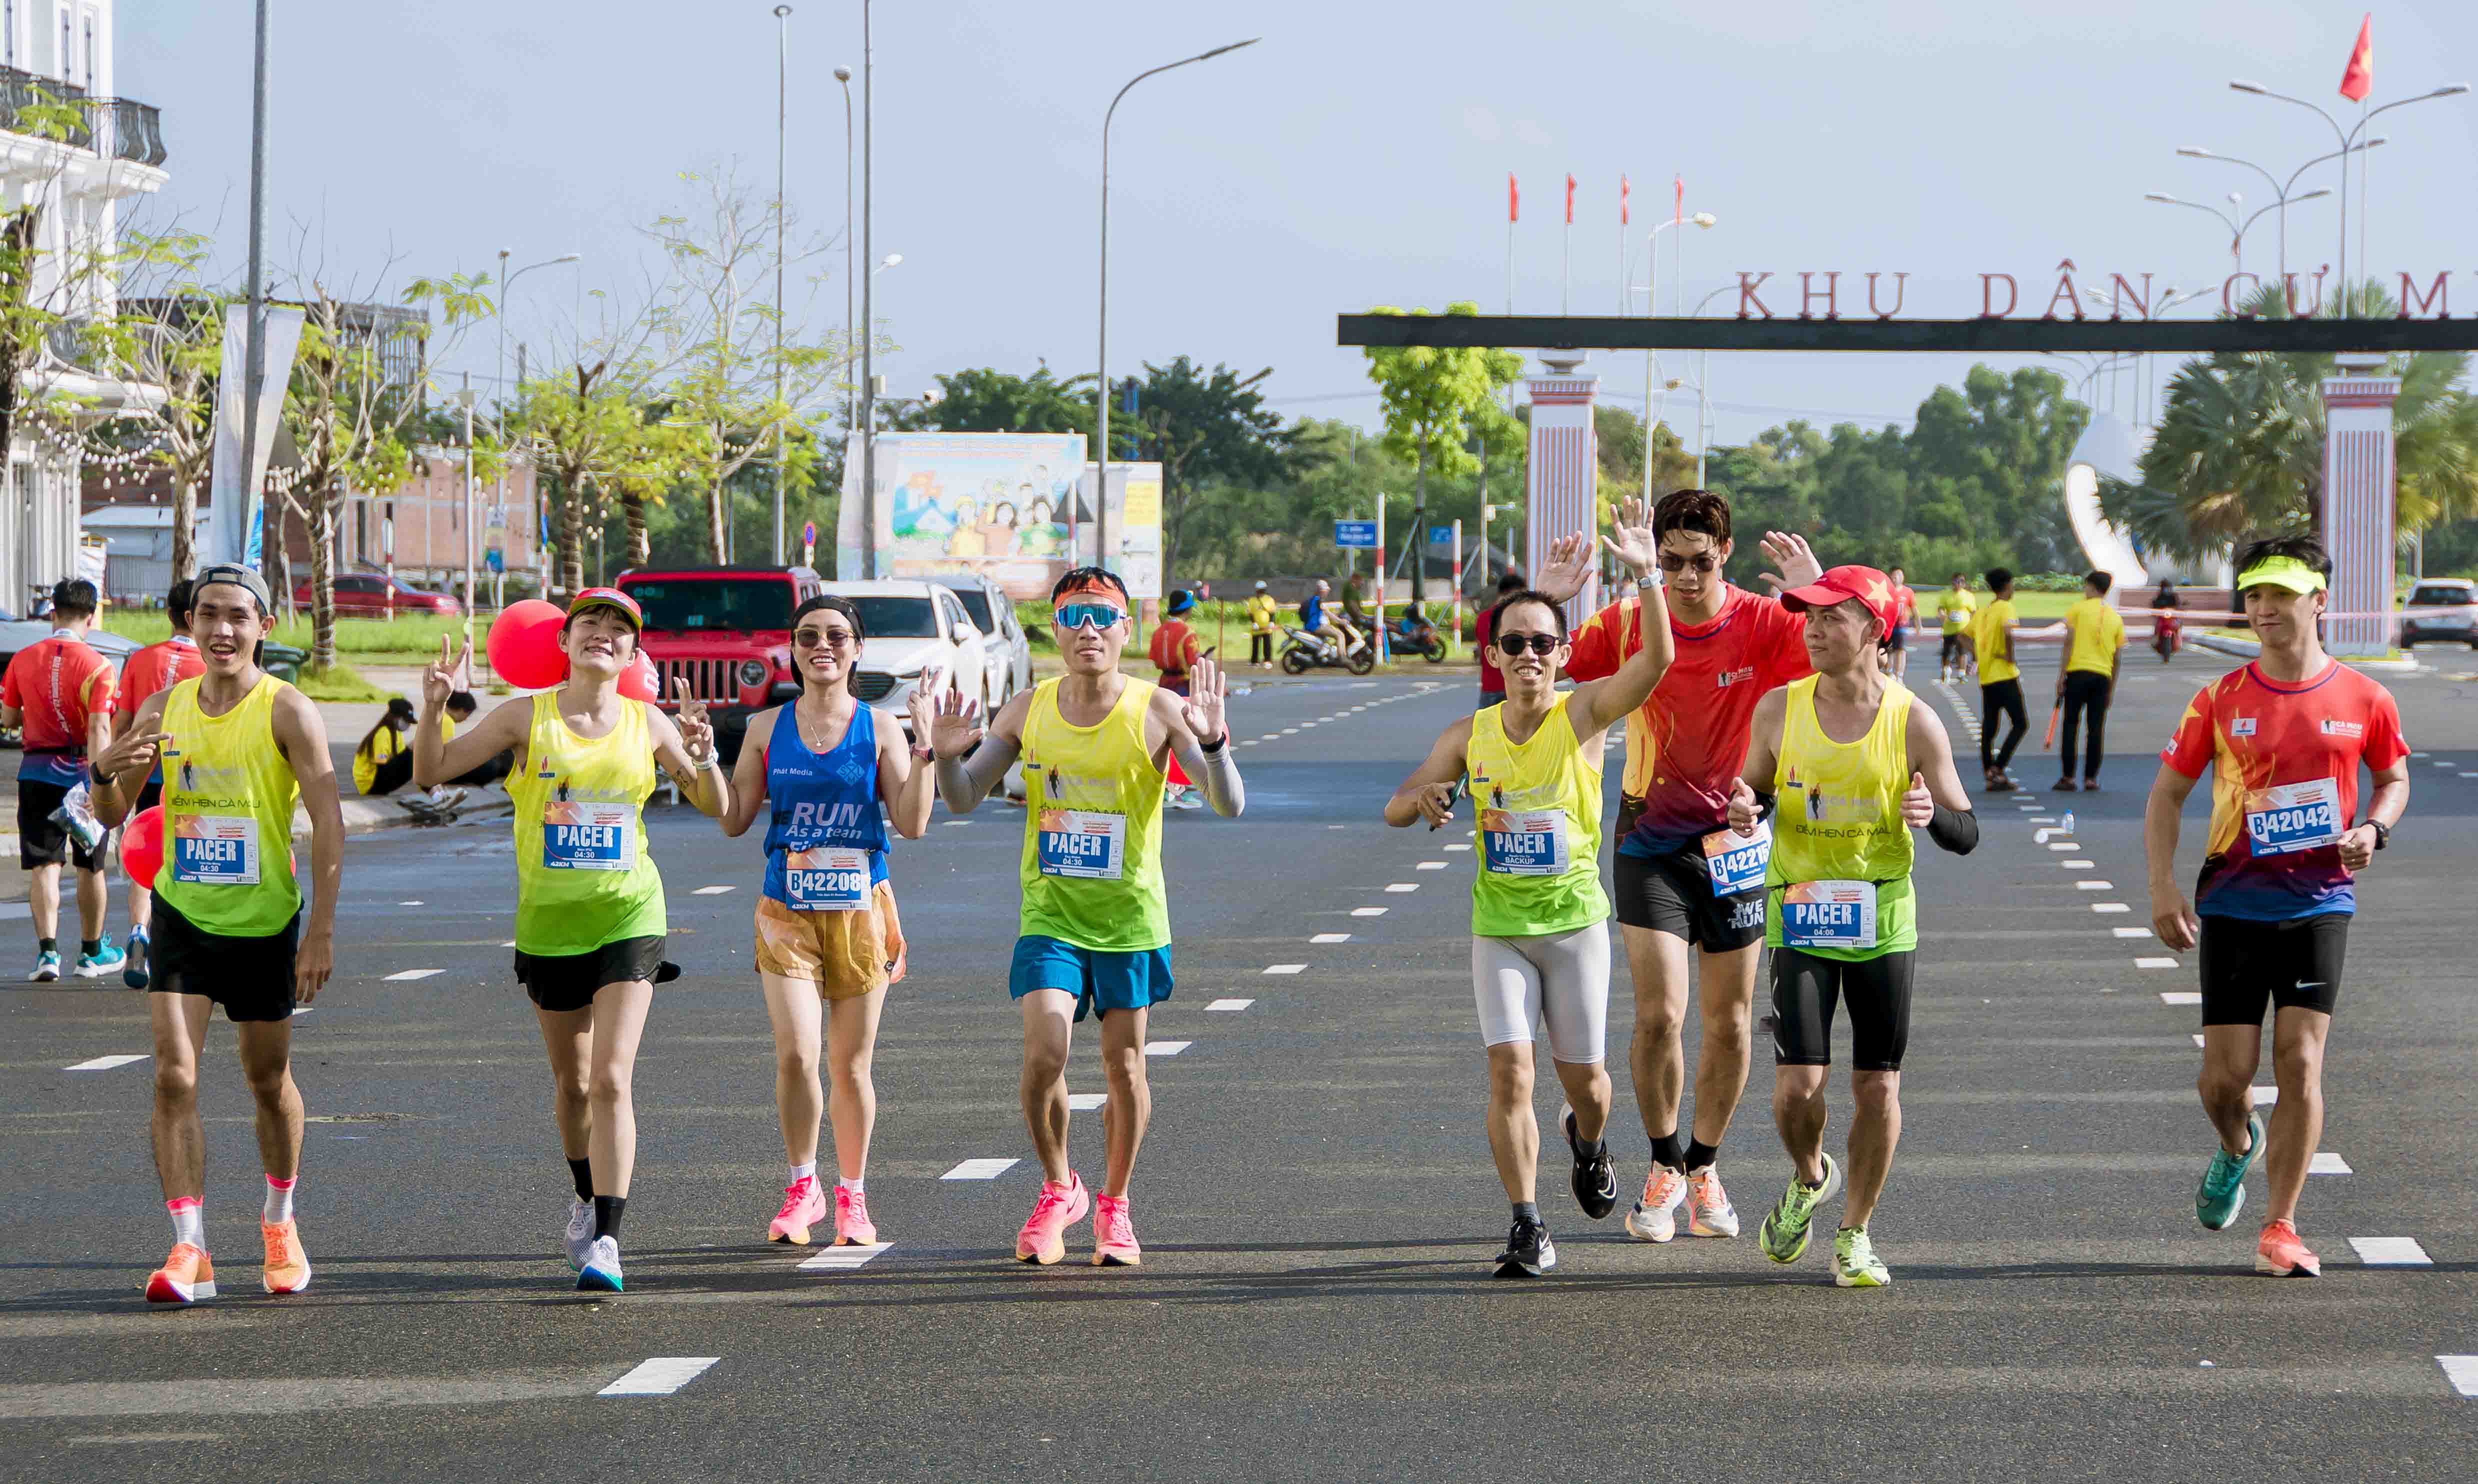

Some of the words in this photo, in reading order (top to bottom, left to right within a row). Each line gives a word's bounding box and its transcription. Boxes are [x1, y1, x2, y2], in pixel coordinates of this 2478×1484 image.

[1736, 270, 1910, 319] KHU
[1978, 258, 2155, 320] DÂN
[2222, 263, 2330, 318] CƯ
[2396, 270, 2478, 319] M
[790, 768, 812, 776] Media
[238, 800, 260, 808] MU
[792, 802, 864, 826] RUN
[558, 826, 613, 848] PACER
[784, 826, 808, 837] As
[812, 828, 822, 838] a
[1494, 832, 1545, 854] PACER
[186, 839, 236, 861] PACER
[1048, 833, 1101, 856] PACER
[792, 872, 861, 892] B42208
[1796, 904, 1852, 924] PACER
